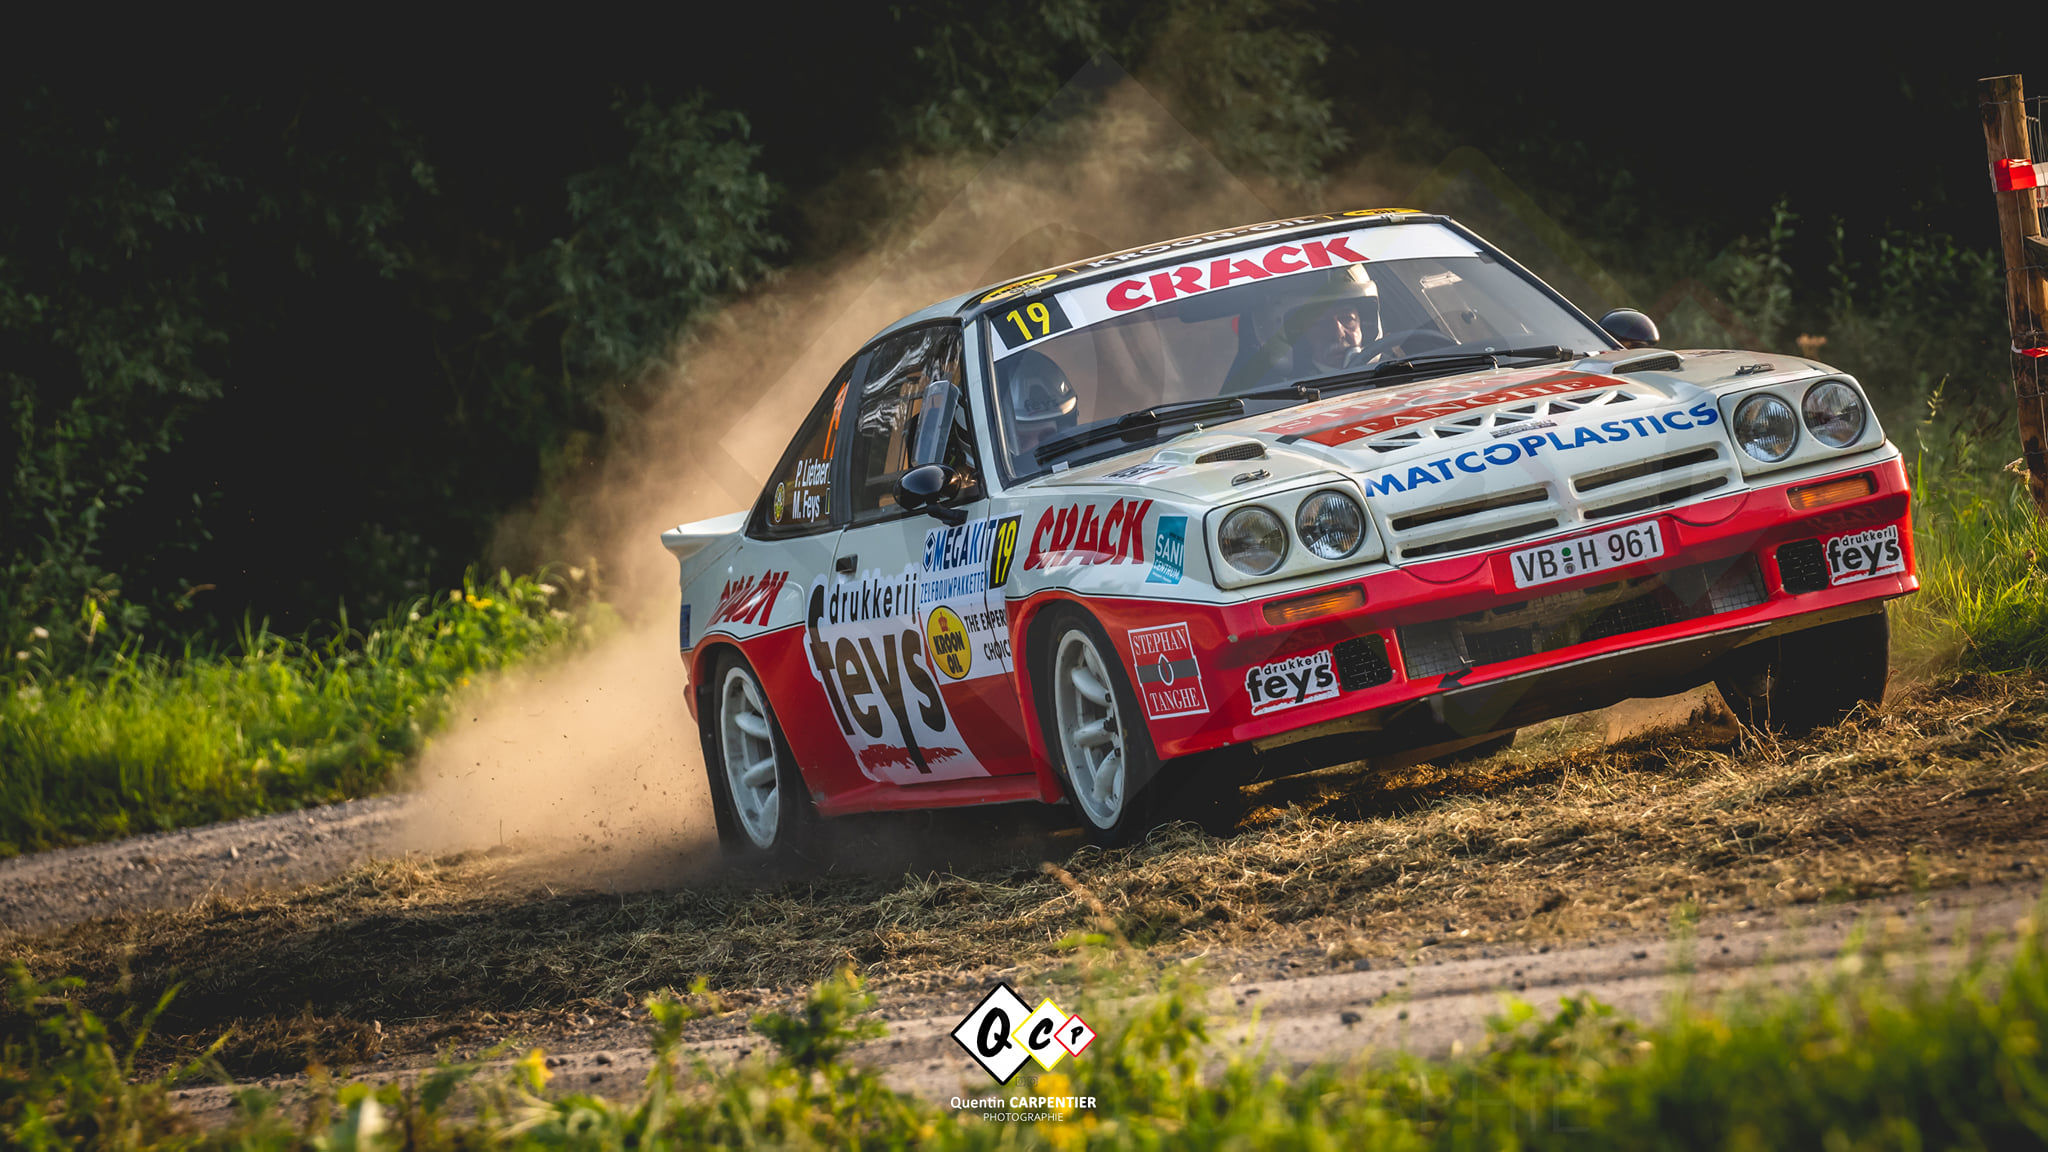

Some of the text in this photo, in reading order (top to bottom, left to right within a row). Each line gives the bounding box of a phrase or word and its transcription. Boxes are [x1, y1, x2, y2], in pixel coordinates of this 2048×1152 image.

[1086, 217, 1315, 268] KROON-OIL
[1105, 236, 1370, 312] CRACK
[1006, 302, 1051, 342] 19
[1340, 381, 1599, 437] TANGHE
[1366, 401, 1719, 498] MATCOPLASTICS
[802, 458, 830, 487] Lietaer
[792, 490, 802, 520] M.
[802, 490, 821, 523] Feys
[932, 519, 997, 572] MEGAKIT
[995, 520, 1017, 584] 19
[1024, 497, 1154, 571] CRACK
[1156, 534, 1185, 567] SANI
[1842, 526, 1897, 546] drukkerij
[1516, 524, 1660, 582] VB H 961
[1828, 539, 1900, 576] feys
[830, 572, 919, 625] drukkerij
[920, 571, 989, 604] ZELFBOUWPAKKETTEN
[964, 608, 1007, 634] THE EXPER
[932, 631, 966, 655] KROON
[983, 639, 1012, 661] CHOIC
[1132, 628, 1187, 656] STEPHAN
[808, 584, 947, 774] feys
[946, 654, 964, 675] OIL
[1264, 651, 1330, 675] drukkerij
[1149, 687, 1201, 713] TANGHE
[1247, 663, 1334, 704] feys
